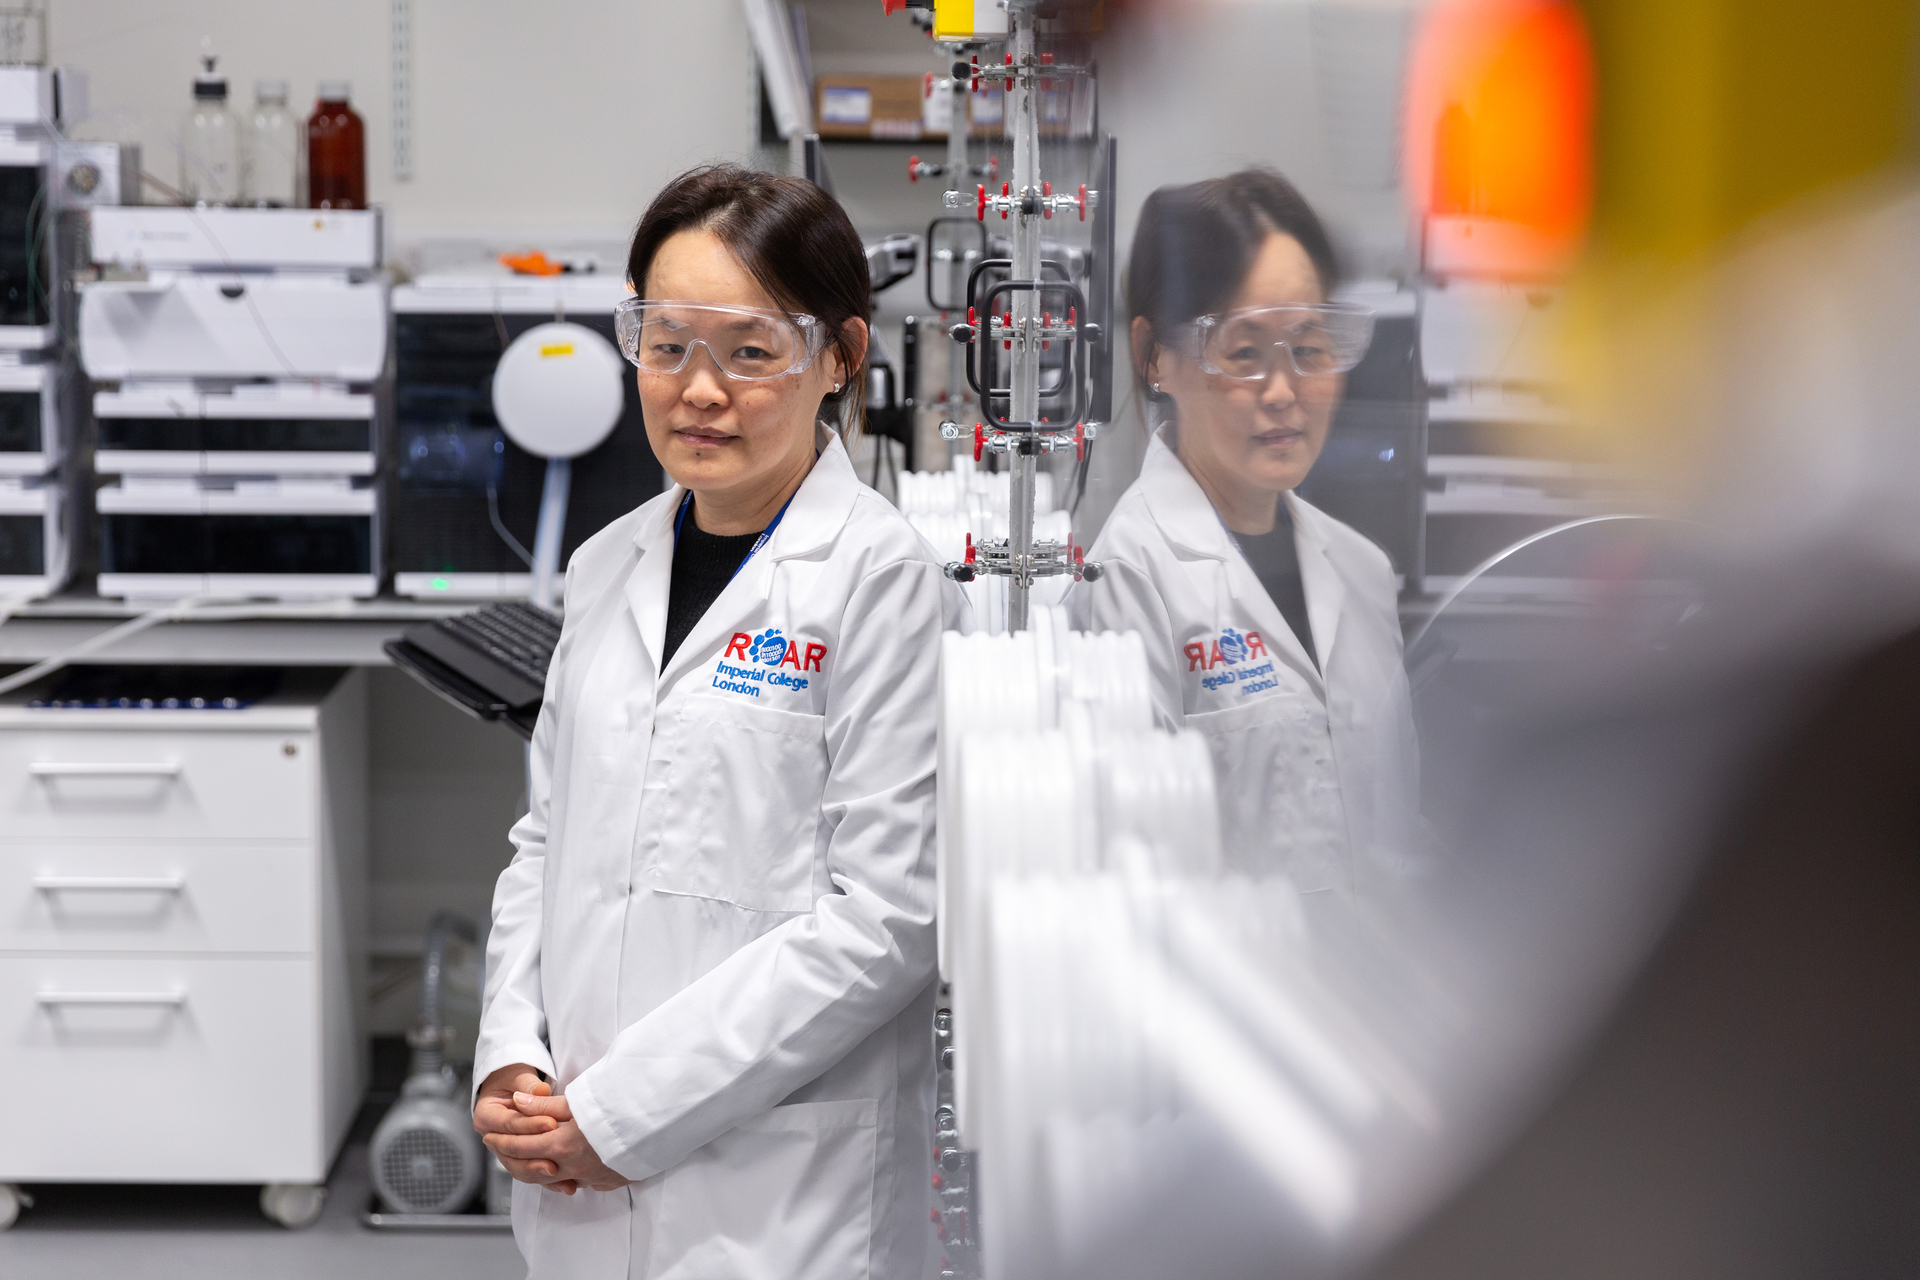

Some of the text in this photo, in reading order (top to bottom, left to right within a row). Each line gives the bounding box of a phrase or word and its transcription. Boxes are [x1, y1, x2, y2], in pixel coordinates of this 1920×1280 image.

[712, 675, 760, 697] London
[716, 660, 809, 692] Imperial College
